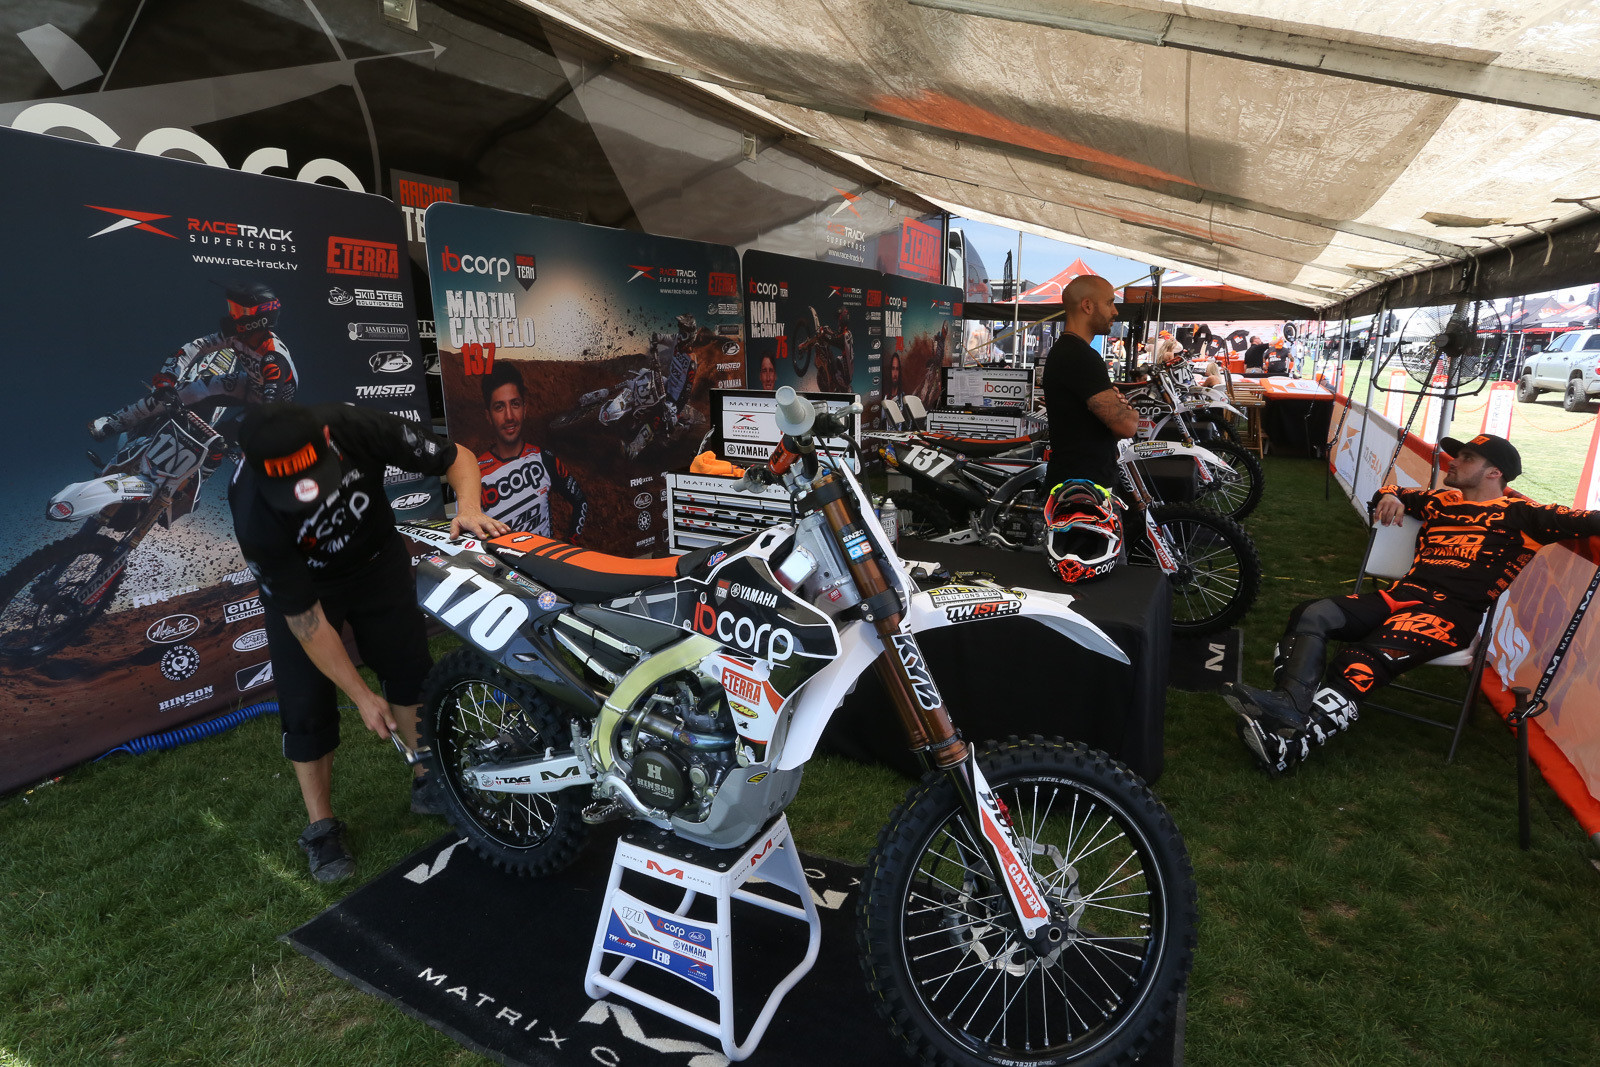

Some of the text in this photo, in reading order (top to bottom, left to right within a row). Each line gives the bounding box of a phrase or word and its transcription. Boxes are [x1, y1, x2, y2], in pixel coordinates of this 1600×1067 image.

[187, 217, 293, 242] RACETRACK
[189, 234, 296, 253] SUPERCROSS
[192, 254, 298, 271] www.race-track.tv
[326, 235, 399, 275] ETERRA
[516, 265, 535, 279] TEAM
[659, 277, 698, 285] SUPERCROSS
[354, 288, 403, 302] SKID STEER
[446, 290, 517, 319] MARTIN
[750, 301, 777, 324] NOAH
[449, 316, 536, 349] CASTELO
[460, 342, 496, 376] 137
[355, 384, 416, 396] TWISTED
[736, 445, 769, 458] YAMAHA
[903, 444, 955, 478] 137
[683, 480, 723, 488] MATRIX
[399, 526, 447, 541] DUNLOP
[739, 585, 779, 609] YAMAHA
[928, 587, 958, 596] SKID
[934, 592, 999, 602] SOLUTIONS.COM
[227, 598, 263, 614] enz
[423, 566, 529, 652] 170
[947, 601, 1020, 619] TWISTED
[1560, 613, 1582, 651] MATRIX
[722, 667, 762, 703] ETERRA
[158, 685, 214, 711] HINSON
[500, 775, 531, 784] TAG
[636, 777, 675, 795] HINSON
[1008, 863, 1042, 916] GALFER
[652, 948, 671, 966] LEIB
[681, 942, 707, 959] YAMAHA
[418, 967, 569, 1049] MATRIX
